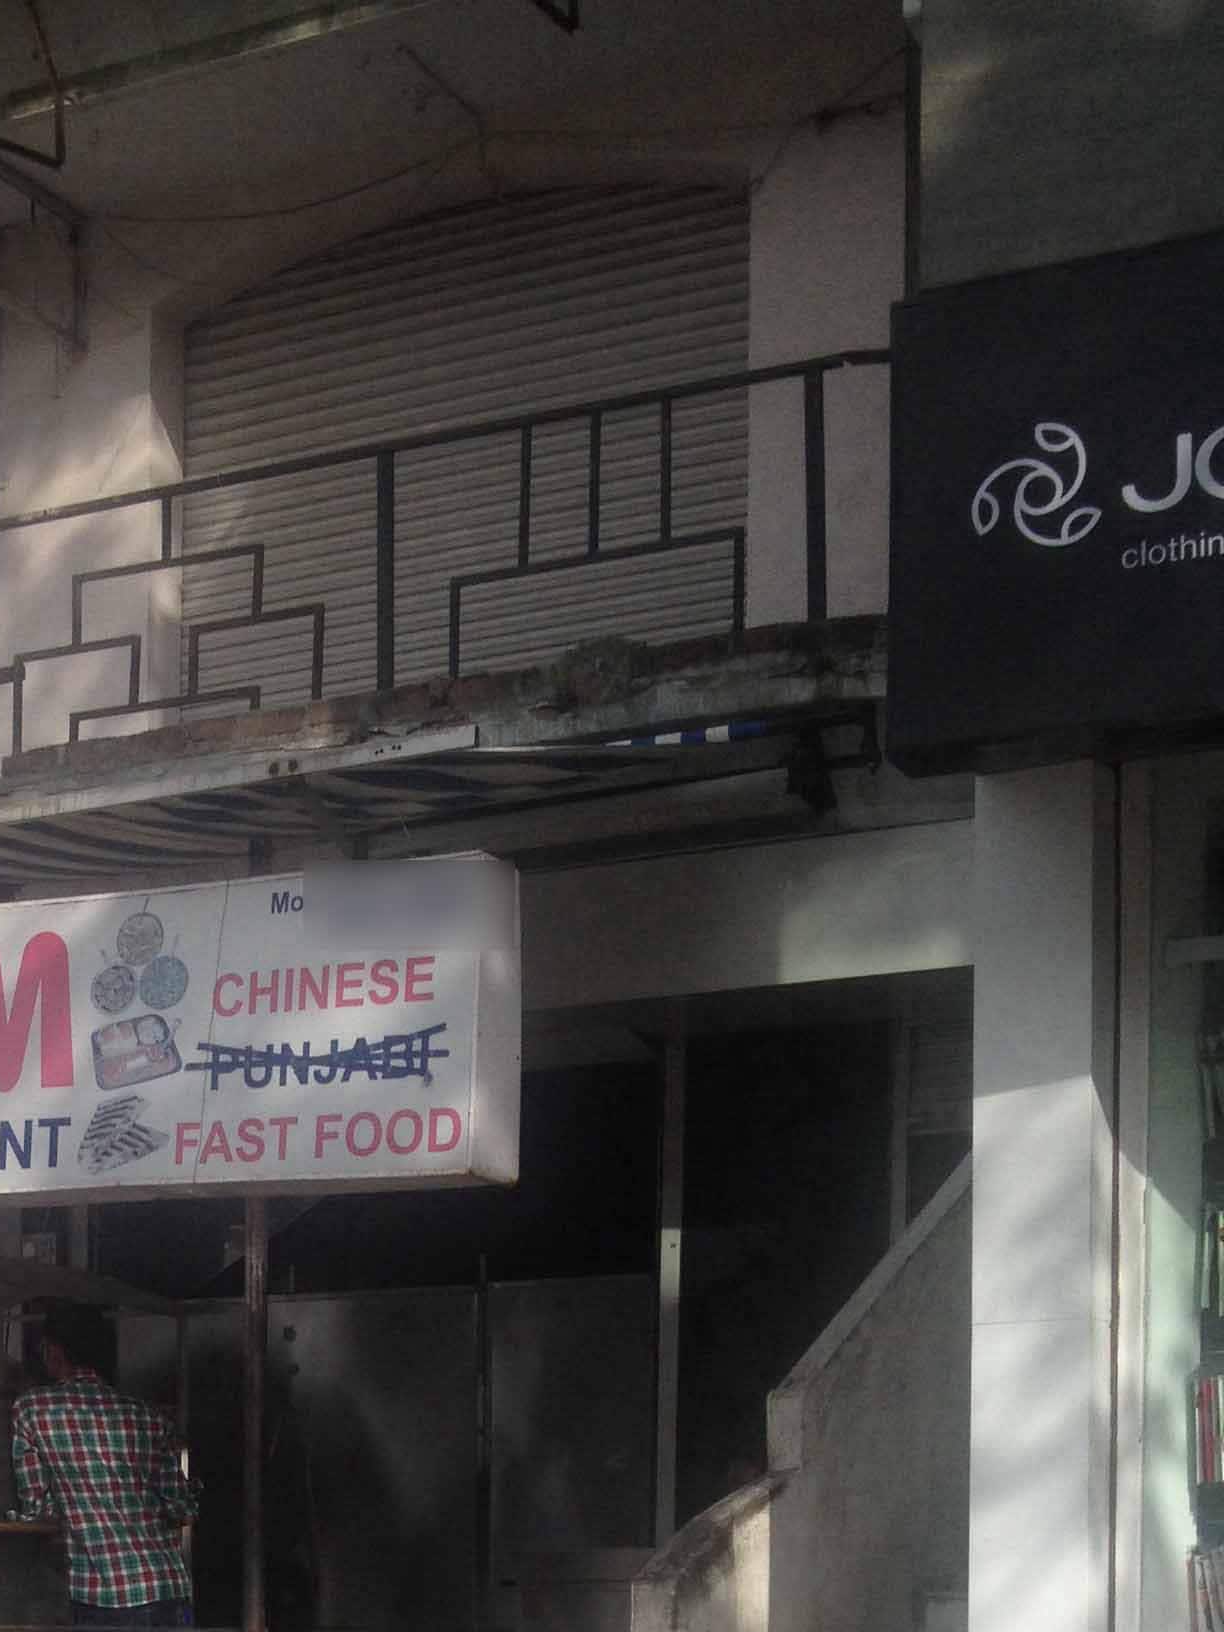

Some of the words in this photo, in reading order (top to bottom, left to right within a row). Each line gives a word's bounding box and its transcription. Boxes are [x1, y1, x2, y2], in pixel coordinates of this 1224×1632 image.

[213, 955, 436, 1017] CHINESE
[175, 1115, 298, 1165] FAST
[314, 1107, 462, 1159] FOOD
